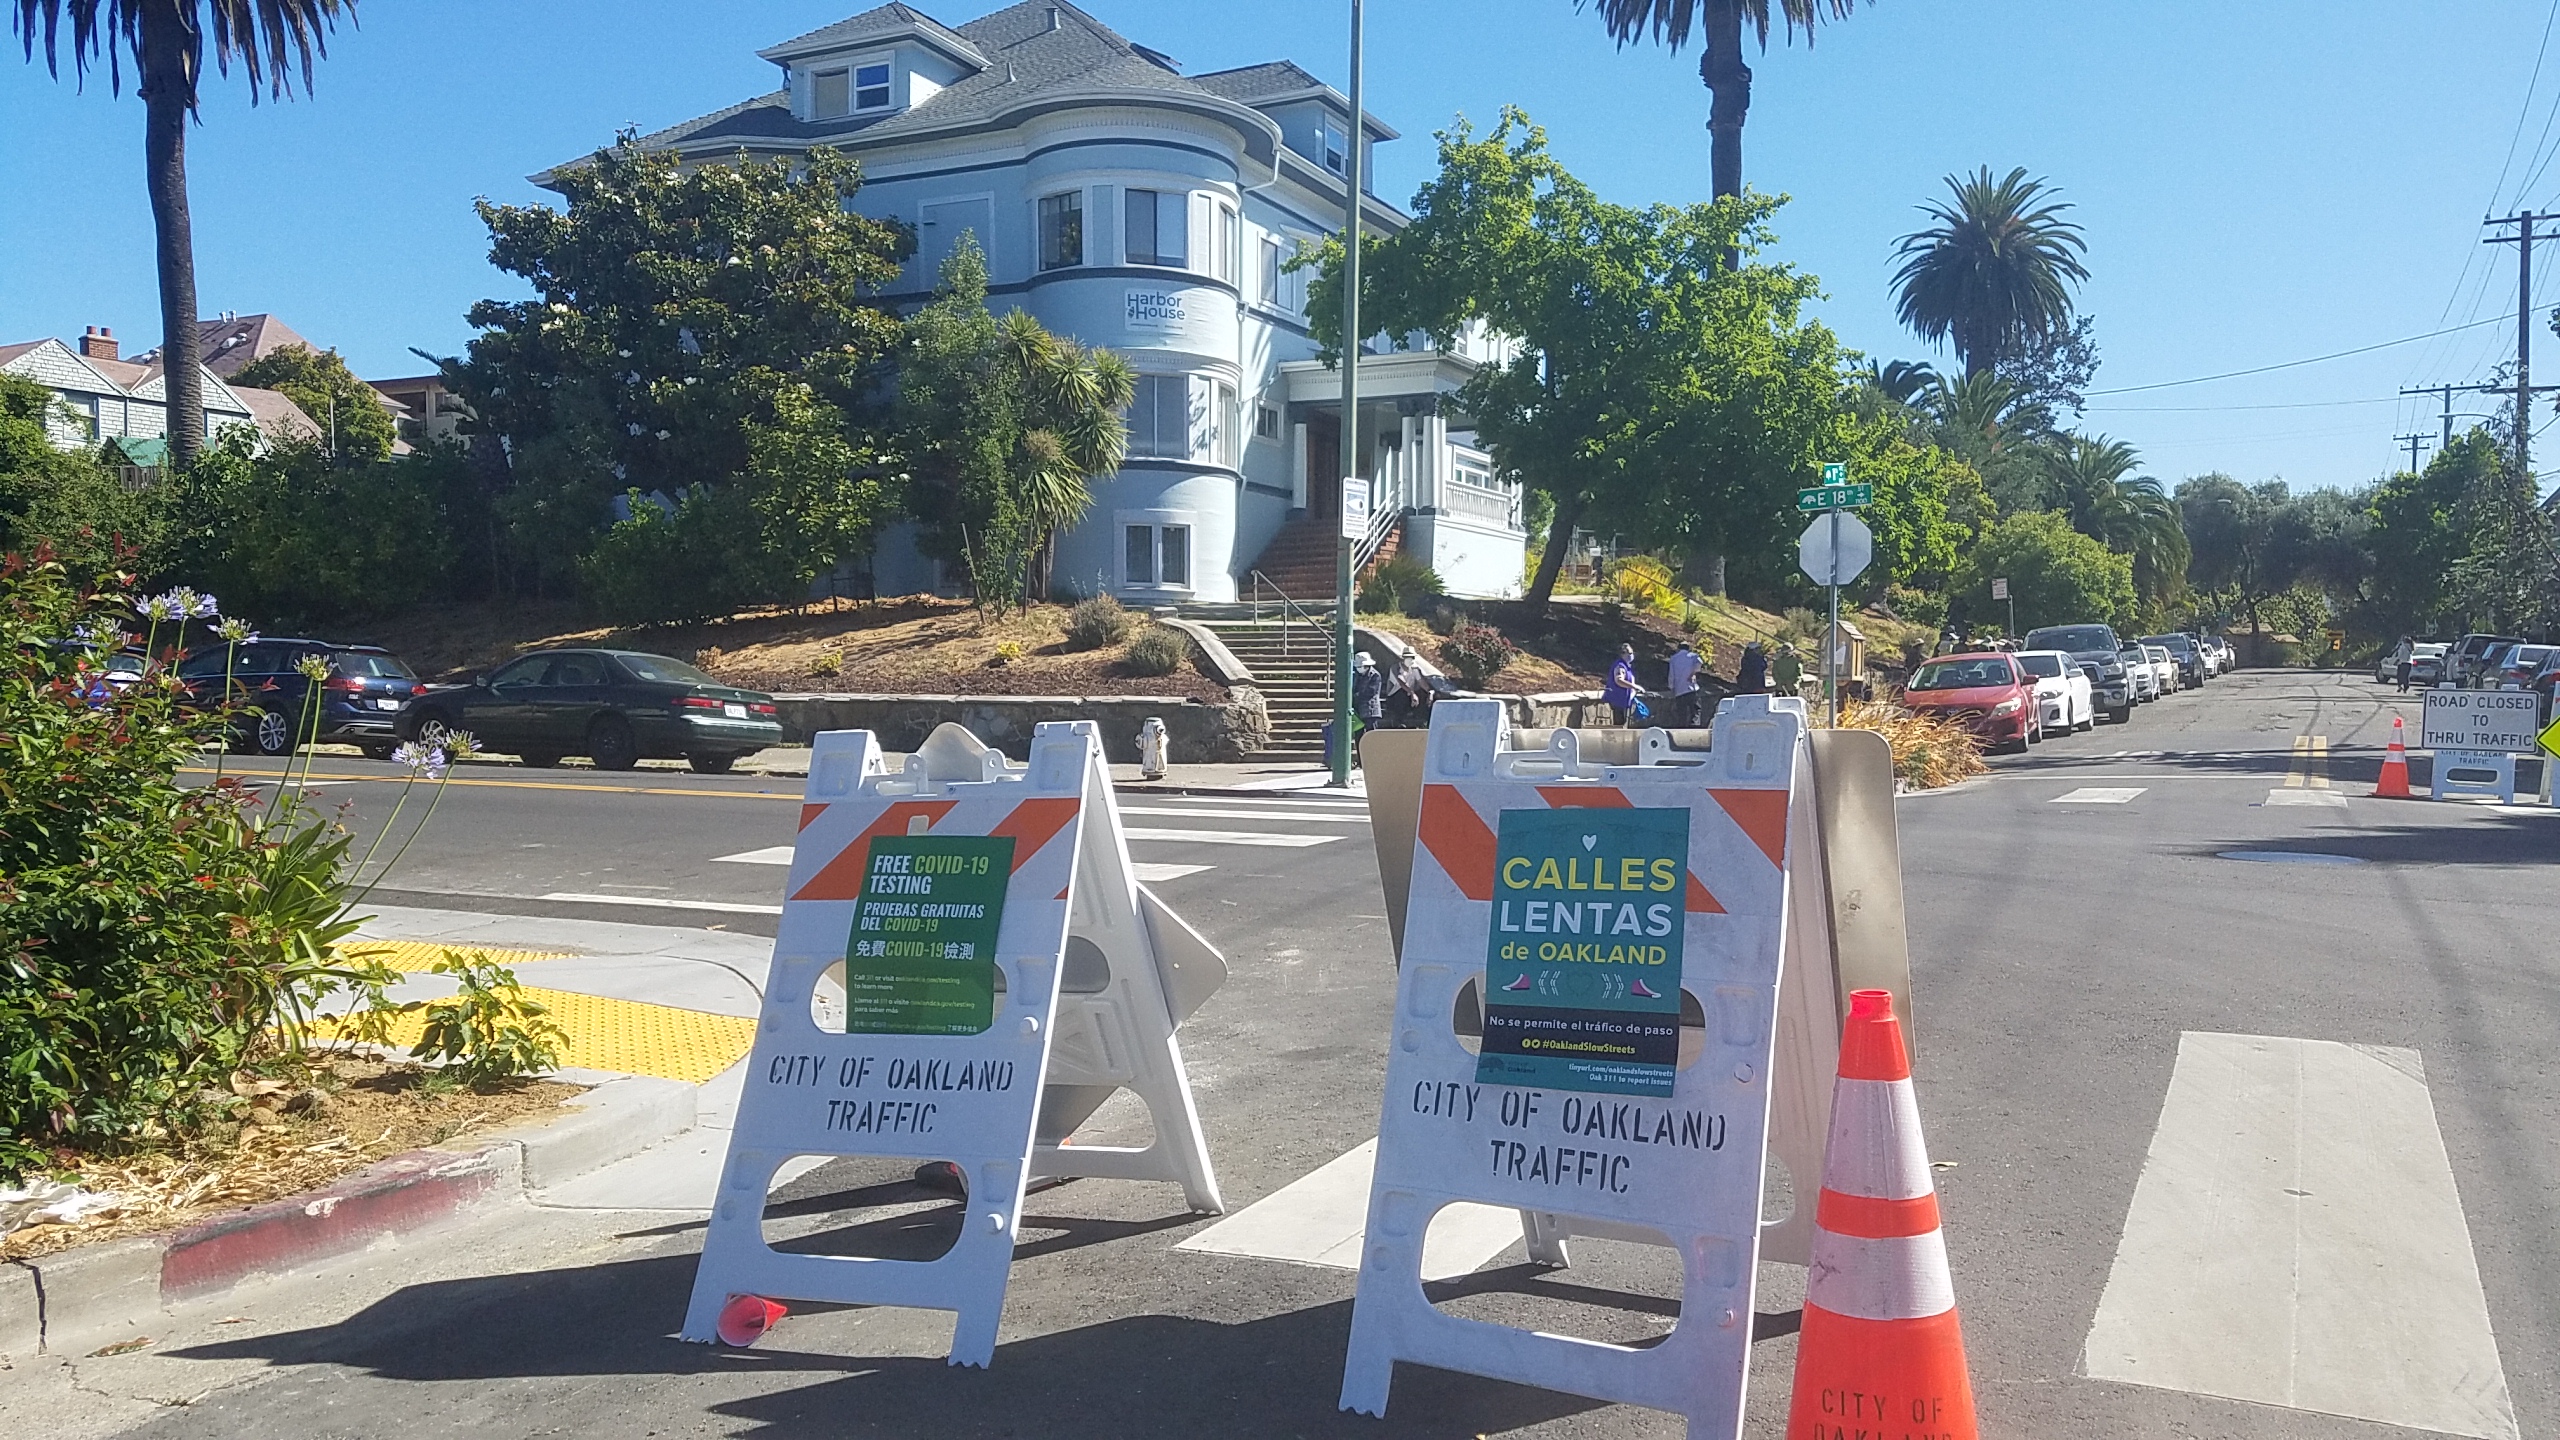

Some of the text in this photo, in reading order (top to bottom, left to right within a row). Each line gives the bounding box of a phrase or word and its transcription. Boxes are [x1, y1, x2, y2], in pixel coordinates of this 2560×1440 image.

[1127, 291, 1182, 307] Harbor
[1136, 306, 1185, 320] House
[1817, 492, 1827, 506] E
[2428, 696, 2533, 709] ROAD CLOSED
[2472, 715, 2489, 726] TO
[2427, 731, 2532, 747] THRU TRAFFIC
[873, 854, 989, 875] FREE COVID-19
[1502, 857, 1676, 891] CALLES
[870, 875, 932, 894] TESTING
[863, 902, 985, 919] PRUEBAS GRATUITAS
[1500, 901, 1672, 937] LENTAS
[860, 917, 939, 932] DEL COVID-19
[1500, 942, 1667, 965] de OAKLAND
[1489, 1016, 1673, 1037] No se permite el tráfico de paso
[1542, 1039, 1636, 1055] #OaklandSlowStreets
[768, 1055, 1014, 1092] CITY OF OAKLAND
[1569, 1063, 1673, 1077] tinyurl.com/oaklandslowstreets
[1589, 1073, 1602, 1081] Oak
[1627, 1077, 1649, 1085] report
[1651, 1077, 1672, 1086] issues
[827, 1099, 937, 1134] TRAFFIC
[1413, 1080, 1726, 1151] CITY OF OAKLAND
[1490, 1139, 1630, 1194] TRAFFIC
[1821, 1388, 1943, 1424] CITY OF
